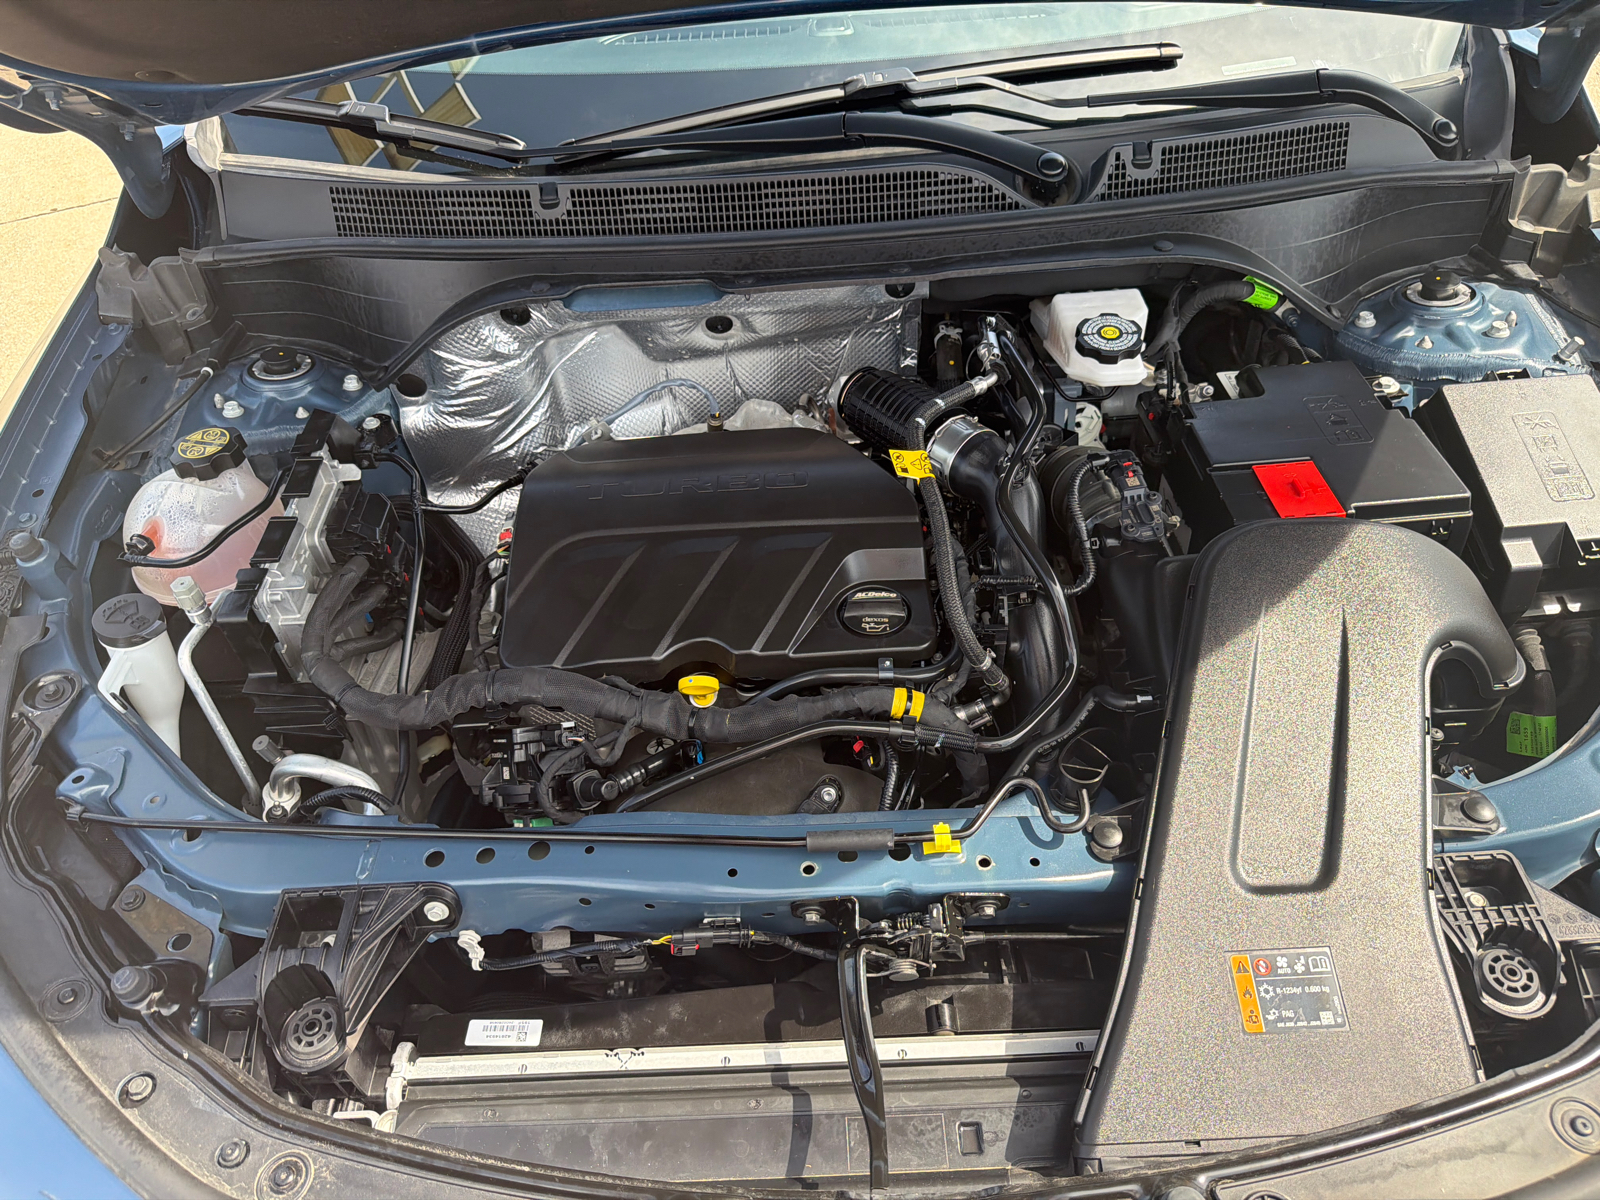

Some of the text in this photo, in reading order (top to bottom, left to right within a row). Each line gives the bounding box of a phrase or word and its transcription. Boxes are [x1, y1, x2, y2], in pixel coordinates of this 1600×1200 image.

[576, 471, 809, 500] TURBO
[854, 591, 897, 599] ACDelco
[1276, 986, 1303, 994] R-1234yf
[1321, 985, 1330, 993] kg
[1281, 1010, 1295, 1018] PAG
